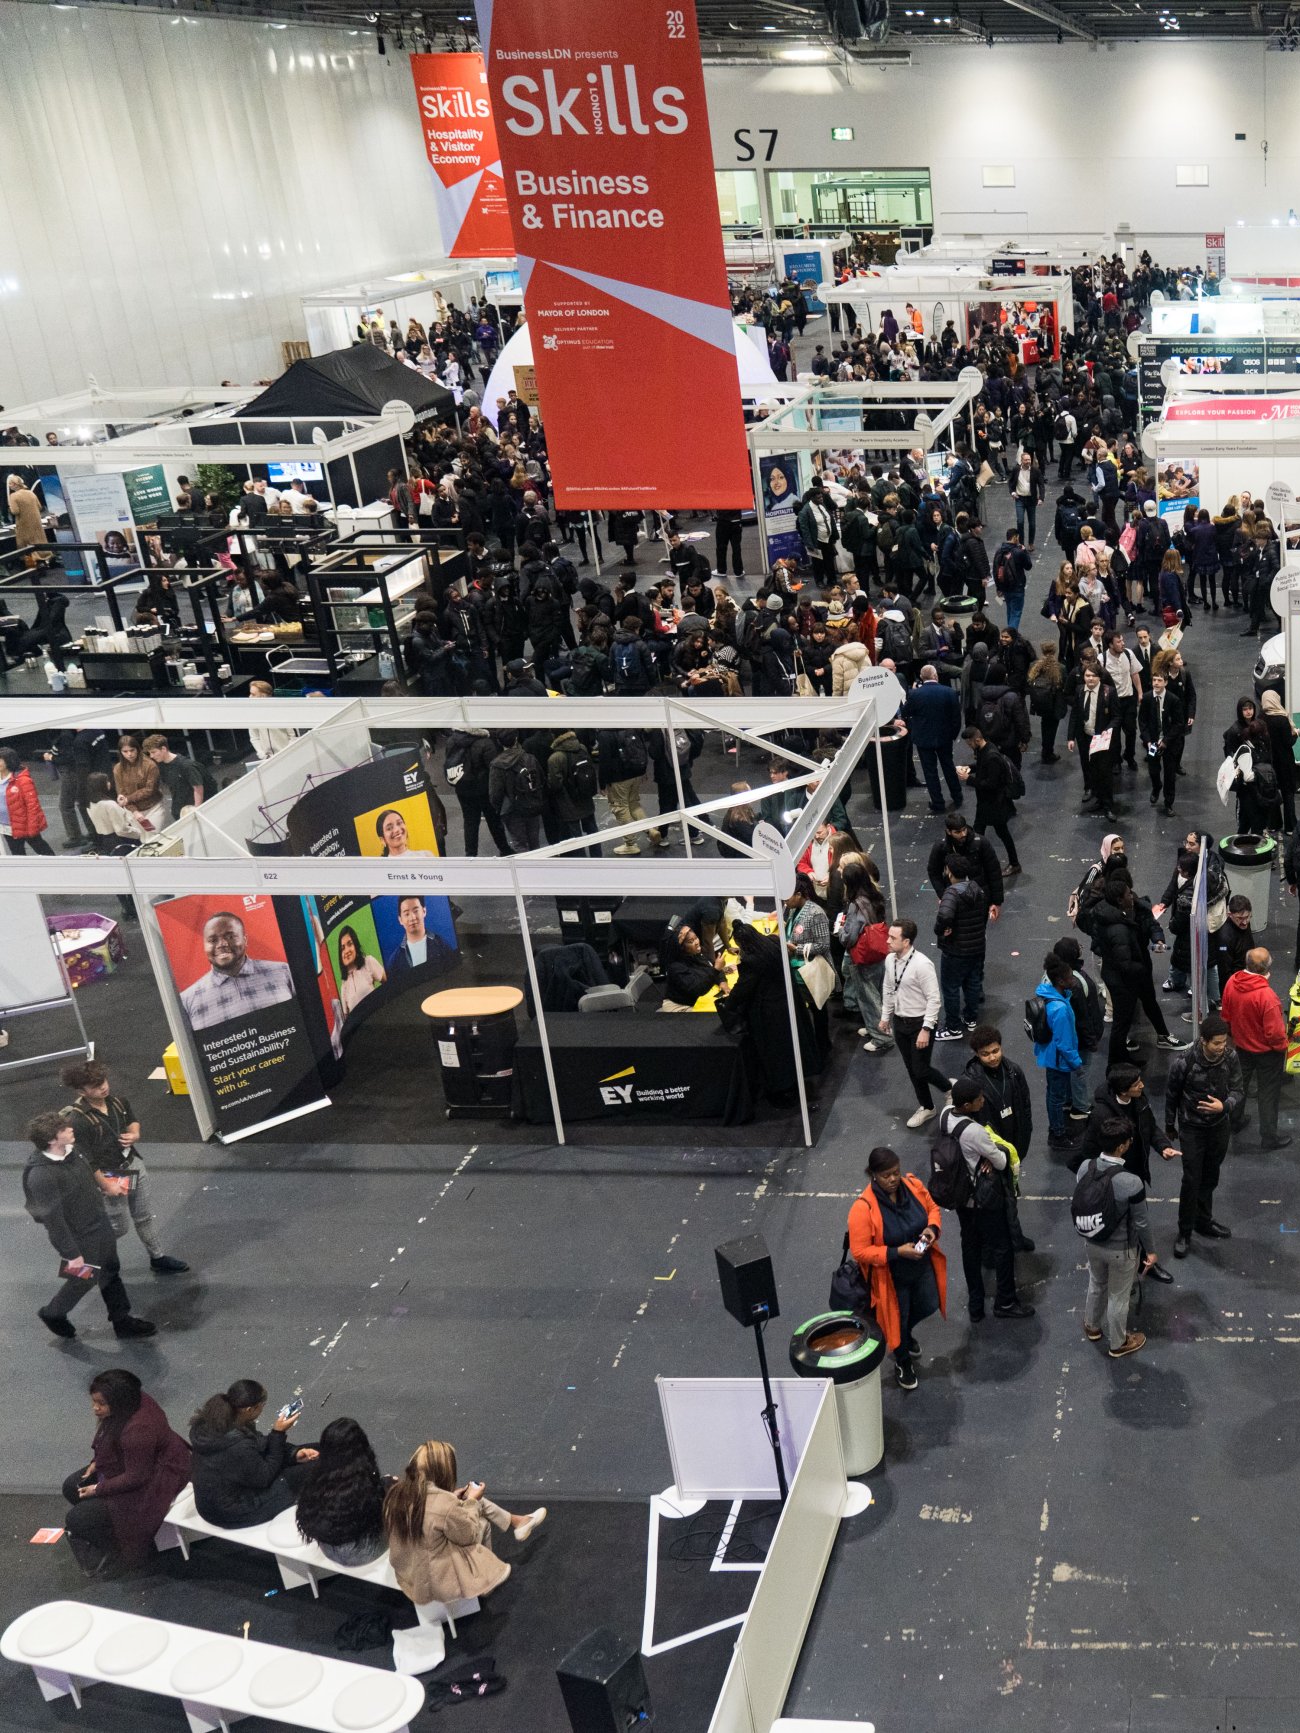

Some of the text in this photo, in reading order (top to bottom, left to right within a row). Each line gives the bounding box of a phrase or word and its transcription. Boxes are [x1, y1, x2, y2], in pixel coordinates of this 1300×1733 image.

[666, 10, 684, 25] 20
[668, 24, 686, 39] 22
[496, 49, 618, 60] BusinessLDN presents
[422, 91, 490, 119] Skills
[502, 64, 688, 136] Skills
[589, 88, 603, 135] LONDON
[427, 129, 484, 142] Hospitality
[430, 141, 475, 152] & Visitor
[734, 128, 779, 162] S7
[432, 154, 481, 166] Economy
[515, 170, 649, 196] Business
[522, 203, 664, 229] & Finance
[1215, 346, 1263, 354] FASHION'S
[765, 507, 794, 518] HOSPITALITY
[858, 674, 884, 684] Business
[862, 680, 884, 690] Finance
[403, 771, 418, 785] EY
[758, 830, 778, 848] Business
[762, 839, 781, 856] Finance
[388, 873, 408, 881] Ernst
[410, 873, 417, 881] &
[418, 873, 443, 882] Young
[242, 894, 257, 906] EY
[203, 1027, 258, 1052] Interested in
[206, 1026, 297, 1061] Technology, Business
[209, 1038, 290, 1073] and Sustainability?
[213, 1054, 286, 1086] Start your career
[216, 1079, 250, 1096] with us.
[600, 1084, 634, 1106] EY
[636, 1089, 664, 1097] Building
[665, 1092, 685, 1100] world
[220, 1088, 273, 1110] ey.com/uk/students
[1075, 1212, 1103, 1231] NIKE
